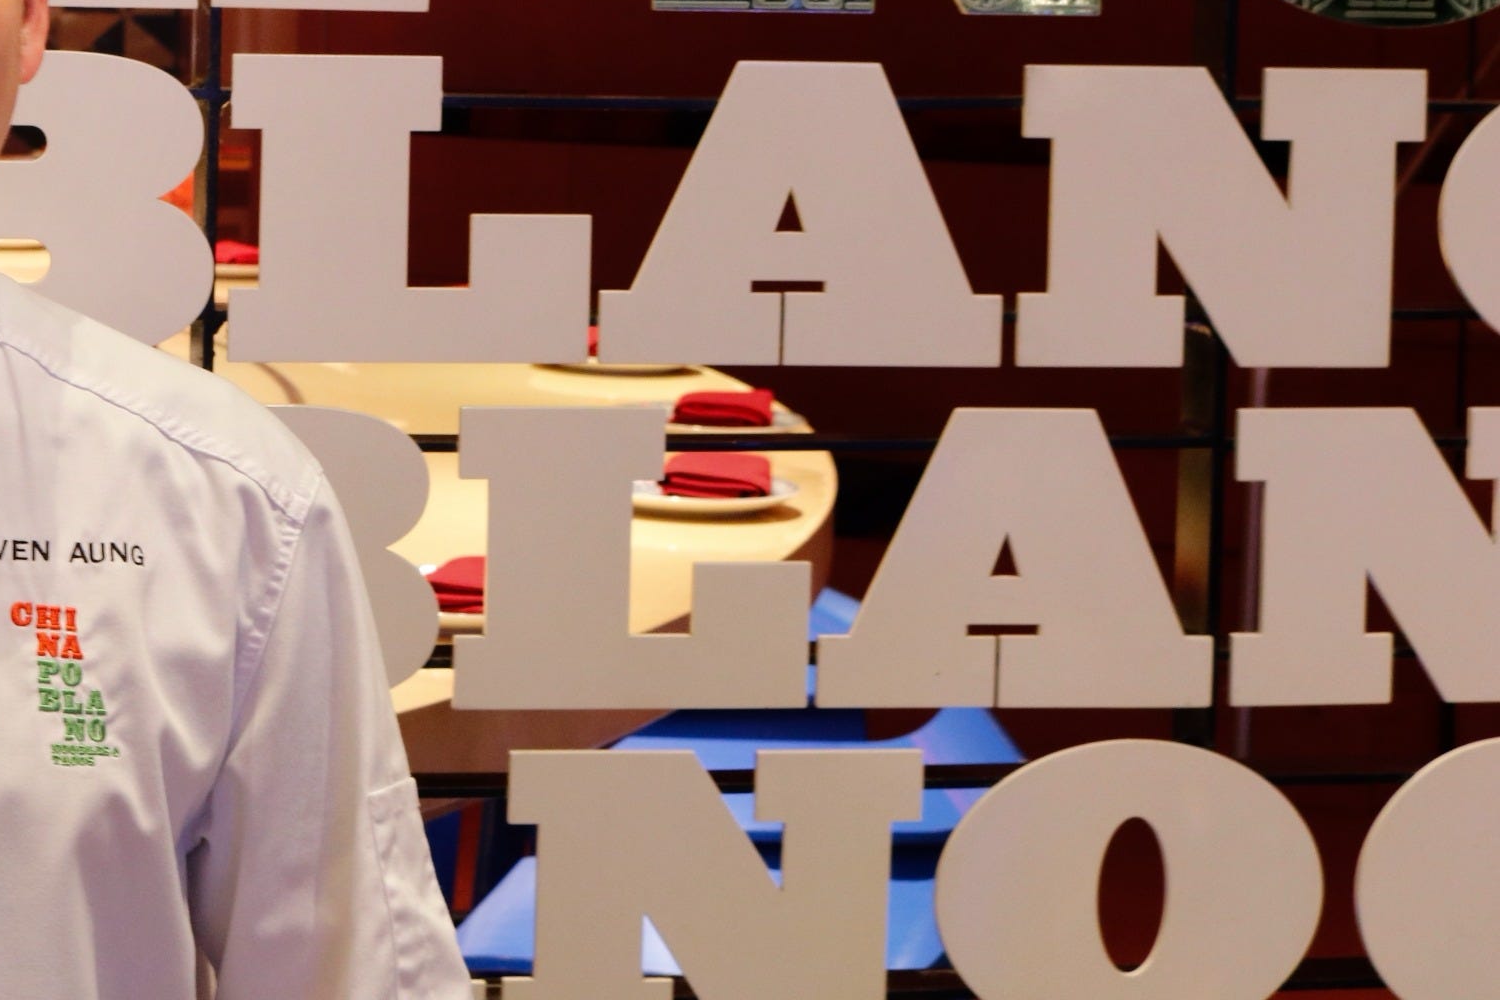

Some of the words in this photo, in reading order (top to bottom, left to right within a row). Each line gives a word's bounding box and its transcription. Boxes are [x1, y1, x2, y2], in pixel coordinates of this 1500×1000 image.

[69, 542, 145, 566] AUNG
[10, 601, 77, 632] CHI
[36, 632, 84, 660] NA
[37, 660, 83, 687] PO
[38, 687, 107, 716] BLA
[63, 717, 107, 742] NO
